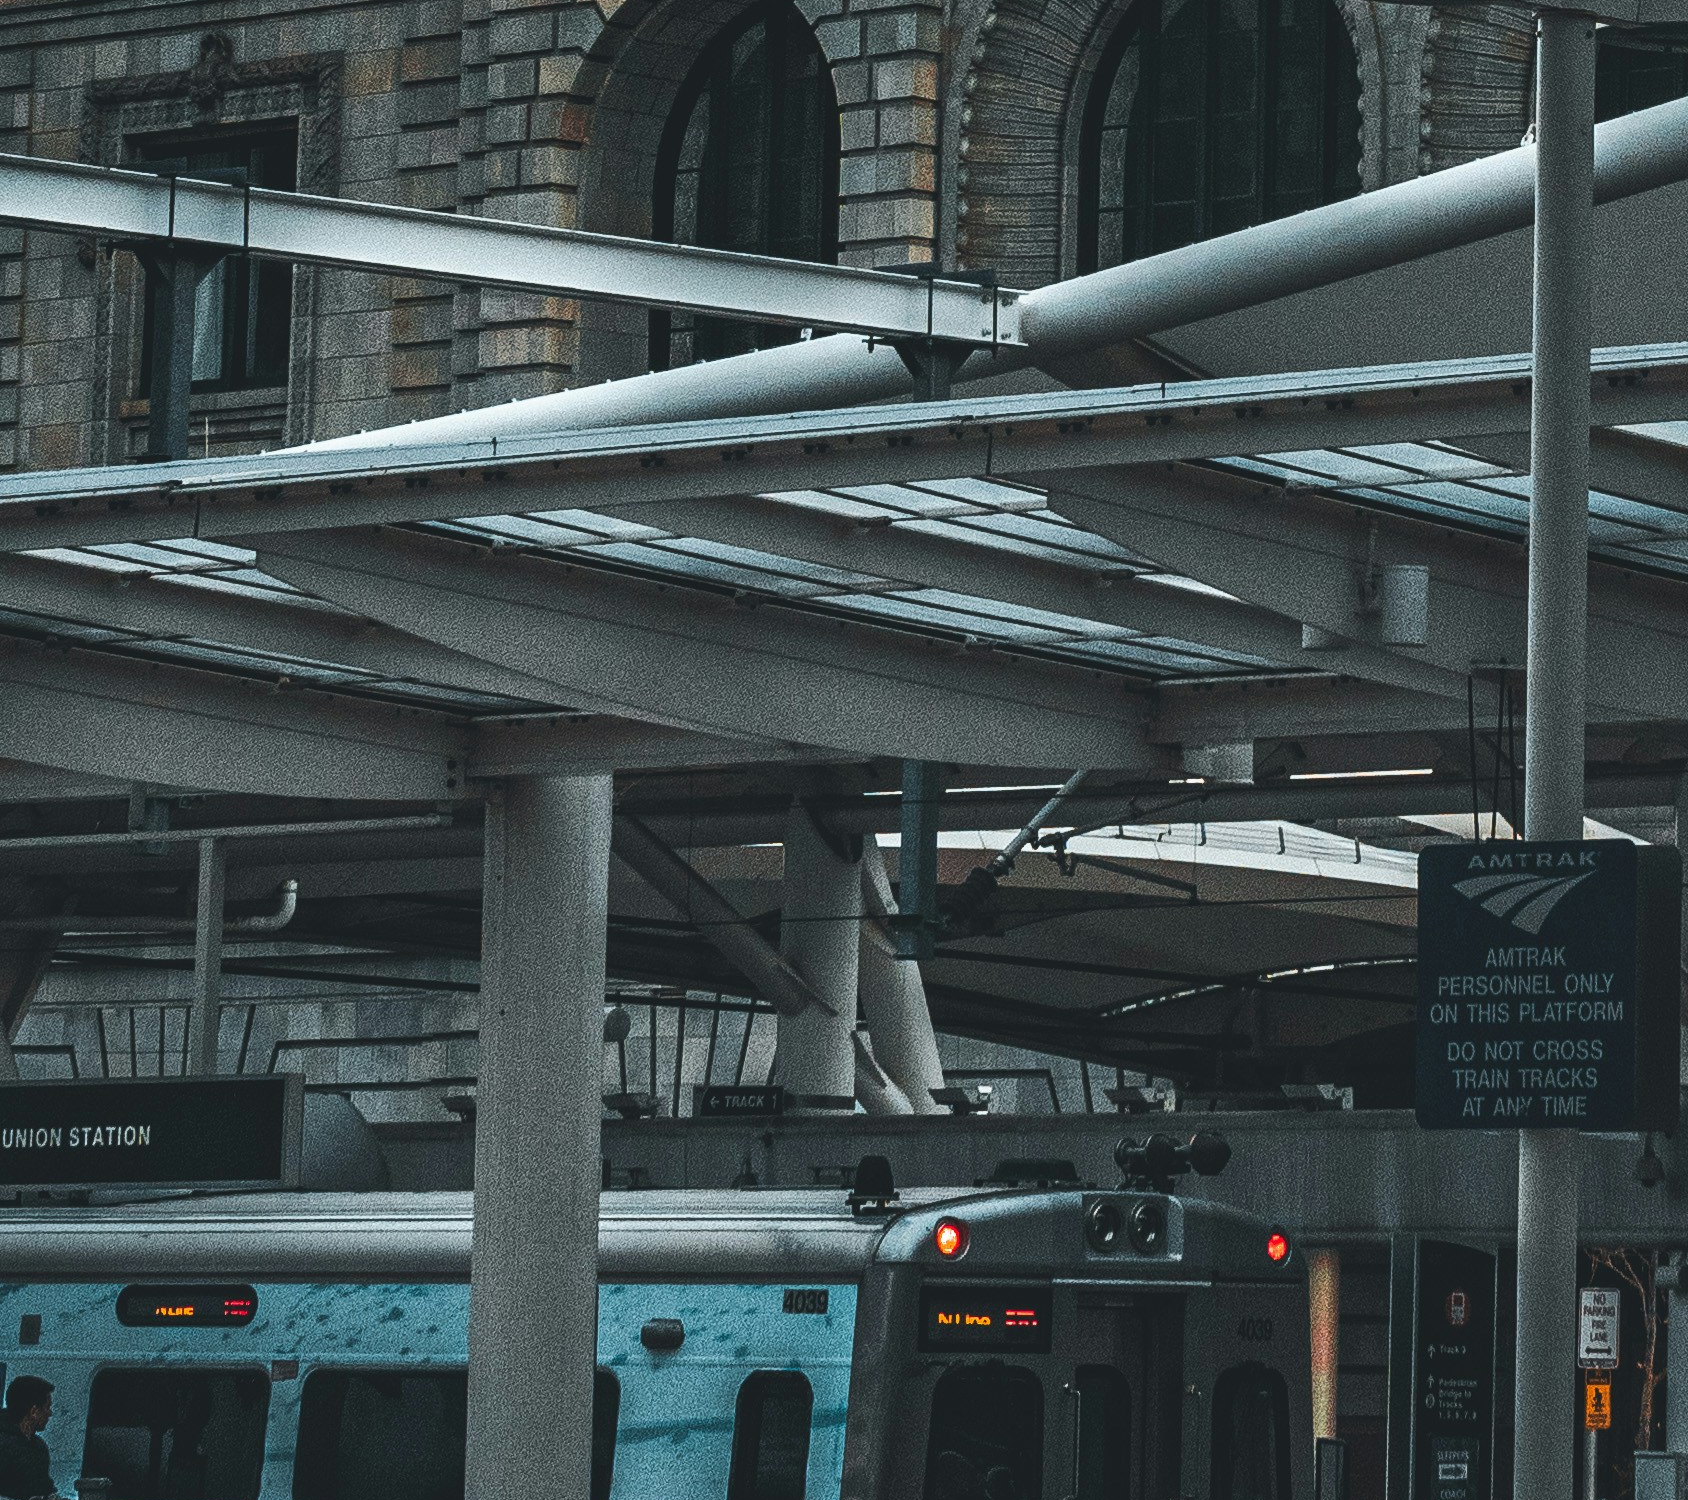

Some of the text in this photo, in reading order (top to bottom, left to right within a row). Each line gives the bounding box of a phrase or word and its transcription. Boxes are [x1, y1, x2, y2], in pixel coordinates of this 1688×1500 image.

[1467, 851, 1597, 869] AMTRAK
[1485, 946, 1567, 968] AMTRAK
[1438, 973, 1614, 996] PERSONNEL ONLY
[1429, 1001, 1624, 1024] ON THIS PLATFORM
[1447, 1039, 1604, 1062] DO NOT CROSS
[1452, 1067, 1598, 1089] TRAIN TRACKS
[724, 1093, 777, 1110] TRACK 1
[1462, 1096, 1587, 1117] AT ANY TIME
[2, 1124, 151, 1149] UNION STATION
[783, 1289, 829, 1315] 4039
[1593, 1293, 1606, 1306] NO
[1583, 1306, 1615, 1317] PARKING
